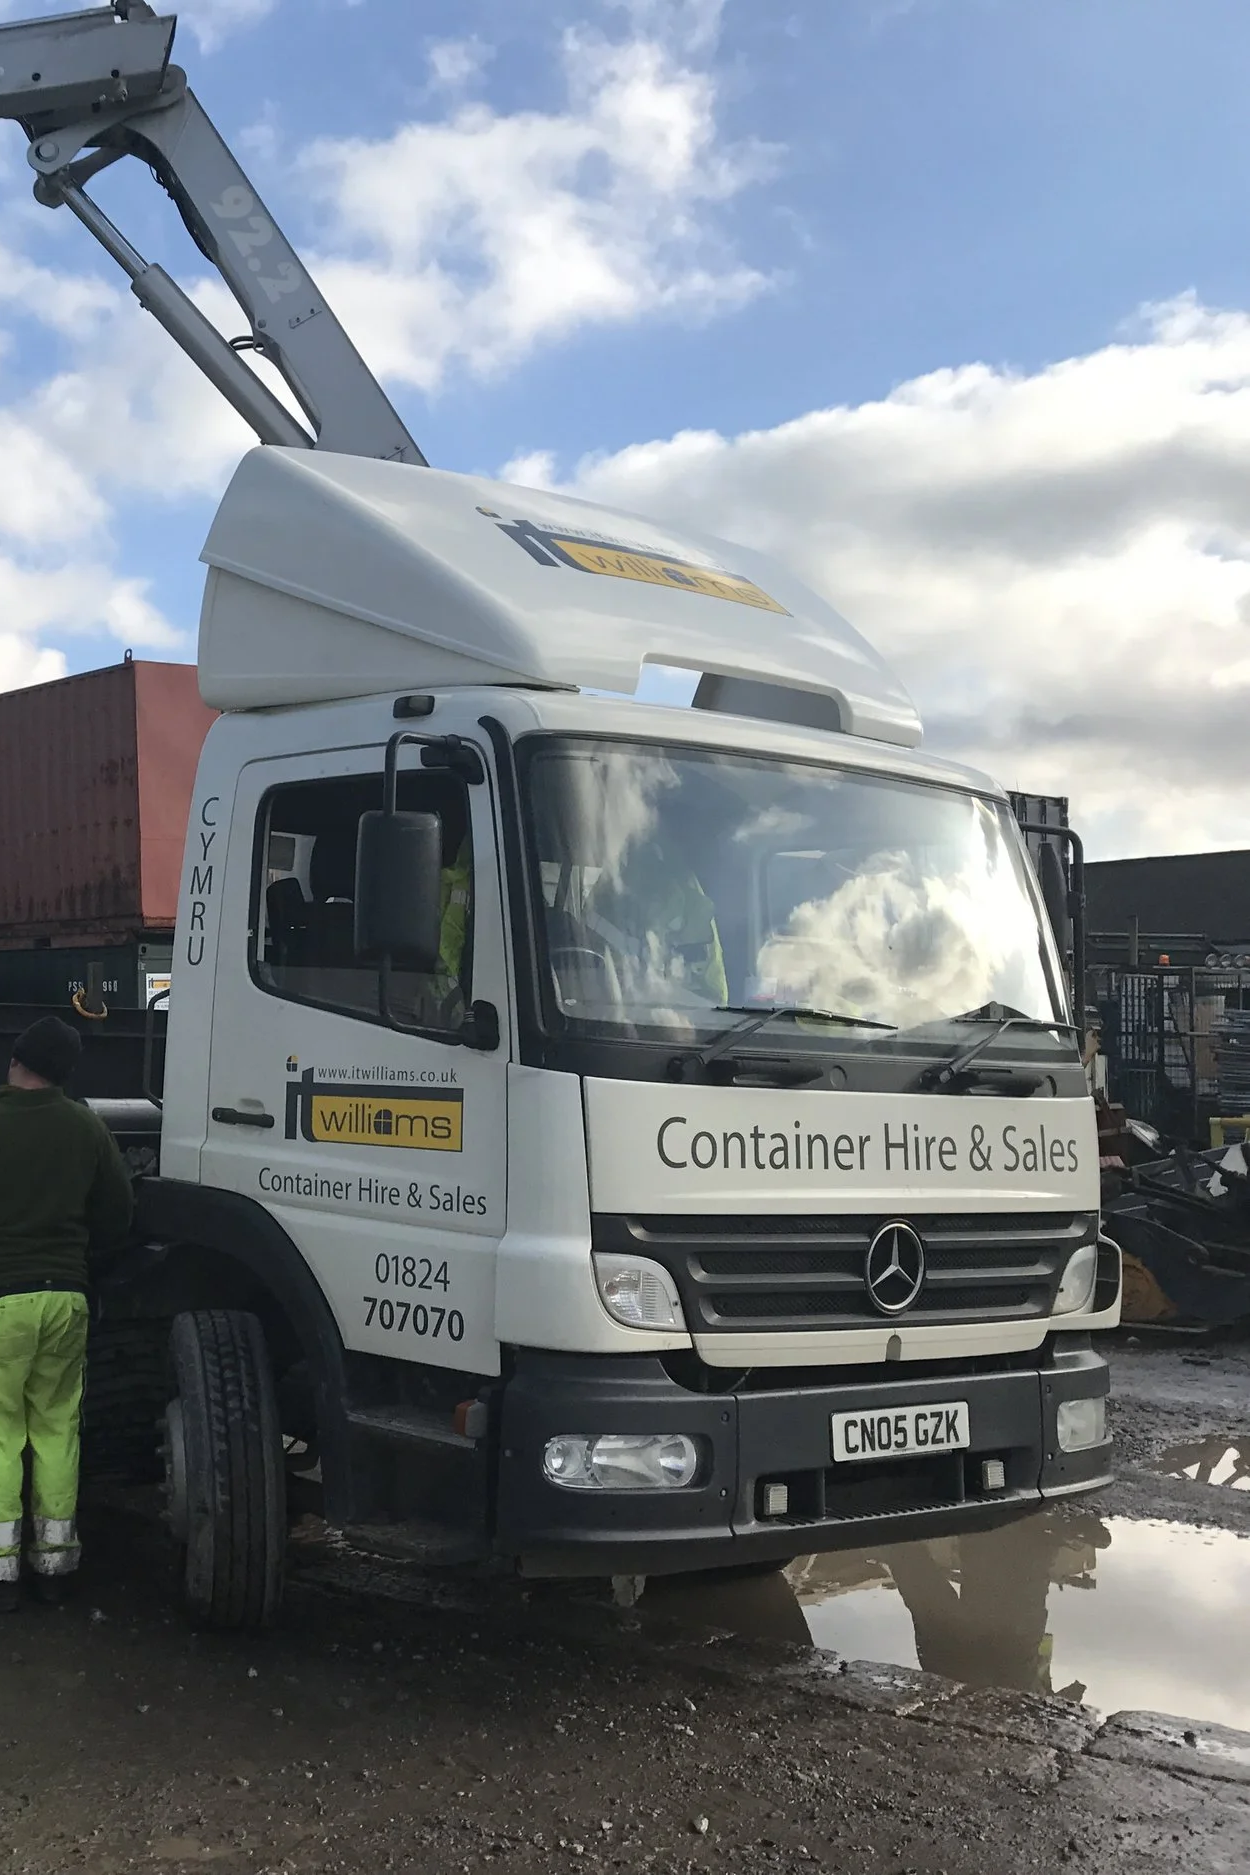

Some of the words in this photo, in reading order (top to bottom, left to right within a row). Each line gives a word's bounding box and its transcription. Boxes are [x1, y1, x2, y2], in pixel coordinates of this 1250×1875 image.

[208, 185, 300, 304] 92.2
[187, 797, 219, 966] CYMRU
[318, 1065, 457, 1083] www.itwilliams.co.uk
[285, 1055, 318, 1143] it
[320, 1103, 451, 1139] williams
[656, 1116, 870, 1172] Container
[883, 1123, 958, 1172] Hire
[969, 1125, 993, 1171] &
[1003, 1124, 1079, 1173] Sales
[258, 1167, 352, 1200] Container
[358, 1177, 400, 1205] Hire
[407, 1182, 422, 1209] &
[429, 1185, 487, 1215] Sales
[375, 1253, 450, 1292] 01824
[363, 1296, 464, 1341] 707070
[844, 1415, 908, 1454] CN05
[915, 1409, 960, 1446] GZK
